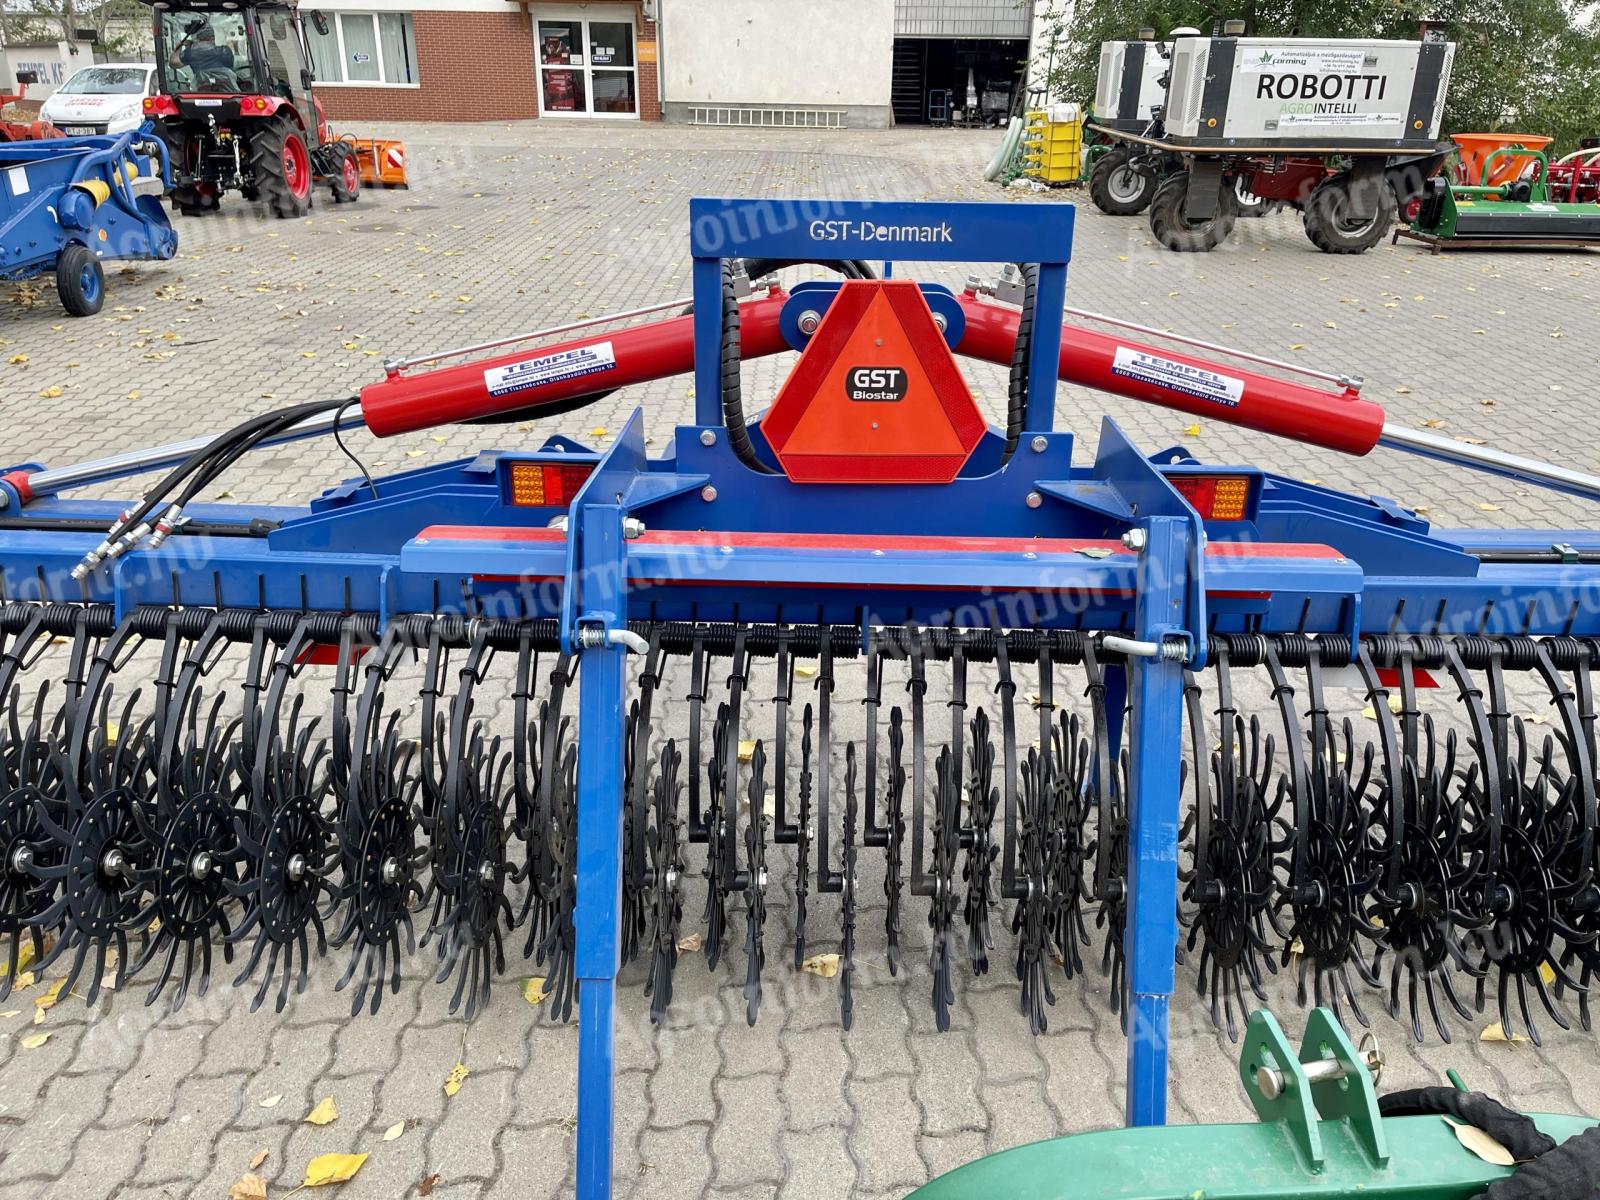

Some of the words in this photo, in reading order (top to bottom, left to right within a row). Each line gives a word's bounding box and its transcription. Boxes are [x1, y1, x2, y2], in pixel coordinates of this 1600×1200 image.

[1257, 74, 1387, 100] ROBOTTI
[1280, 103, 1357, 114] AGROINTELLI
[809, 220, 953, 243] GST-Denmark
[503, 349, 593, 374] TEMPEL
[1136, 353, 1225, 384] TEMPEL
[853, 368, 902, 388] GST
[852, 389, 900, 402] Biostar
